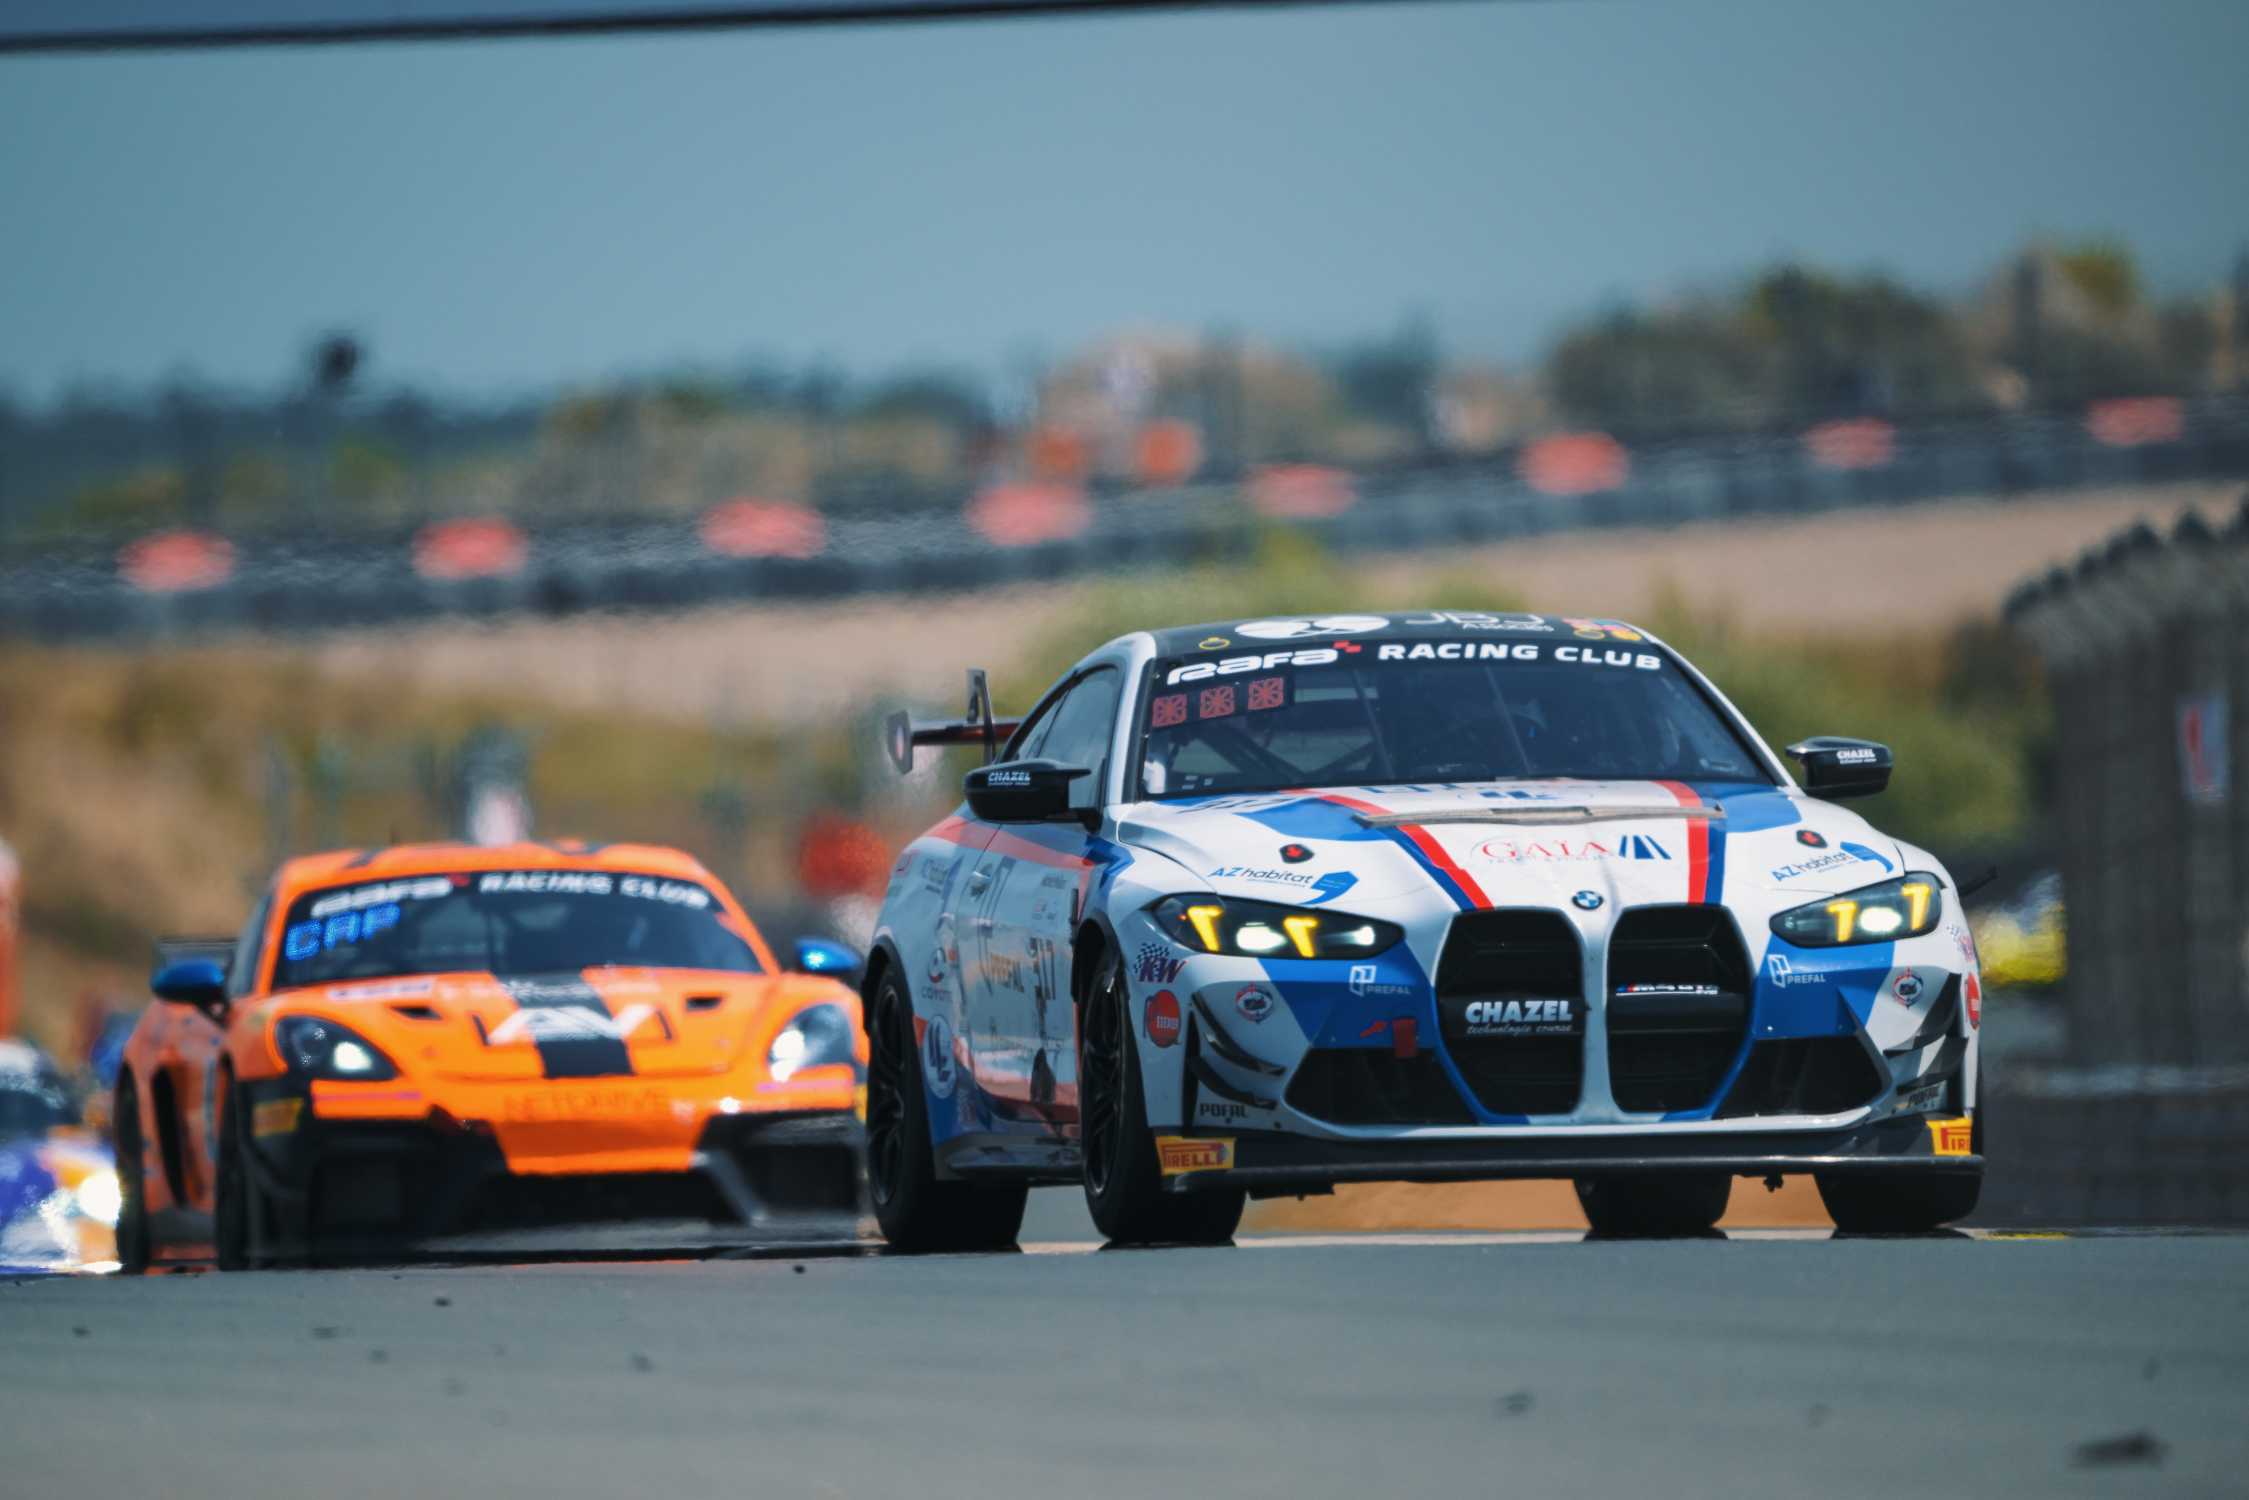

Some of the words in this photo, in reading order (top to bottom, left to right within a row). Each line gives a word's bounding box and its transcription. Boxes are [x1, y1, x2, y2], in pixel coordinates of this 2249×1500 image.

[1378, 643, 1539, 660] RACING
[1553, 646, 1662, 671] CLUB
[1138, 956, 1187, 984] KW
[1786, 973, 1827, 985] PREFAL
[1465, 1000, 1574, 1024] CHAZEL
